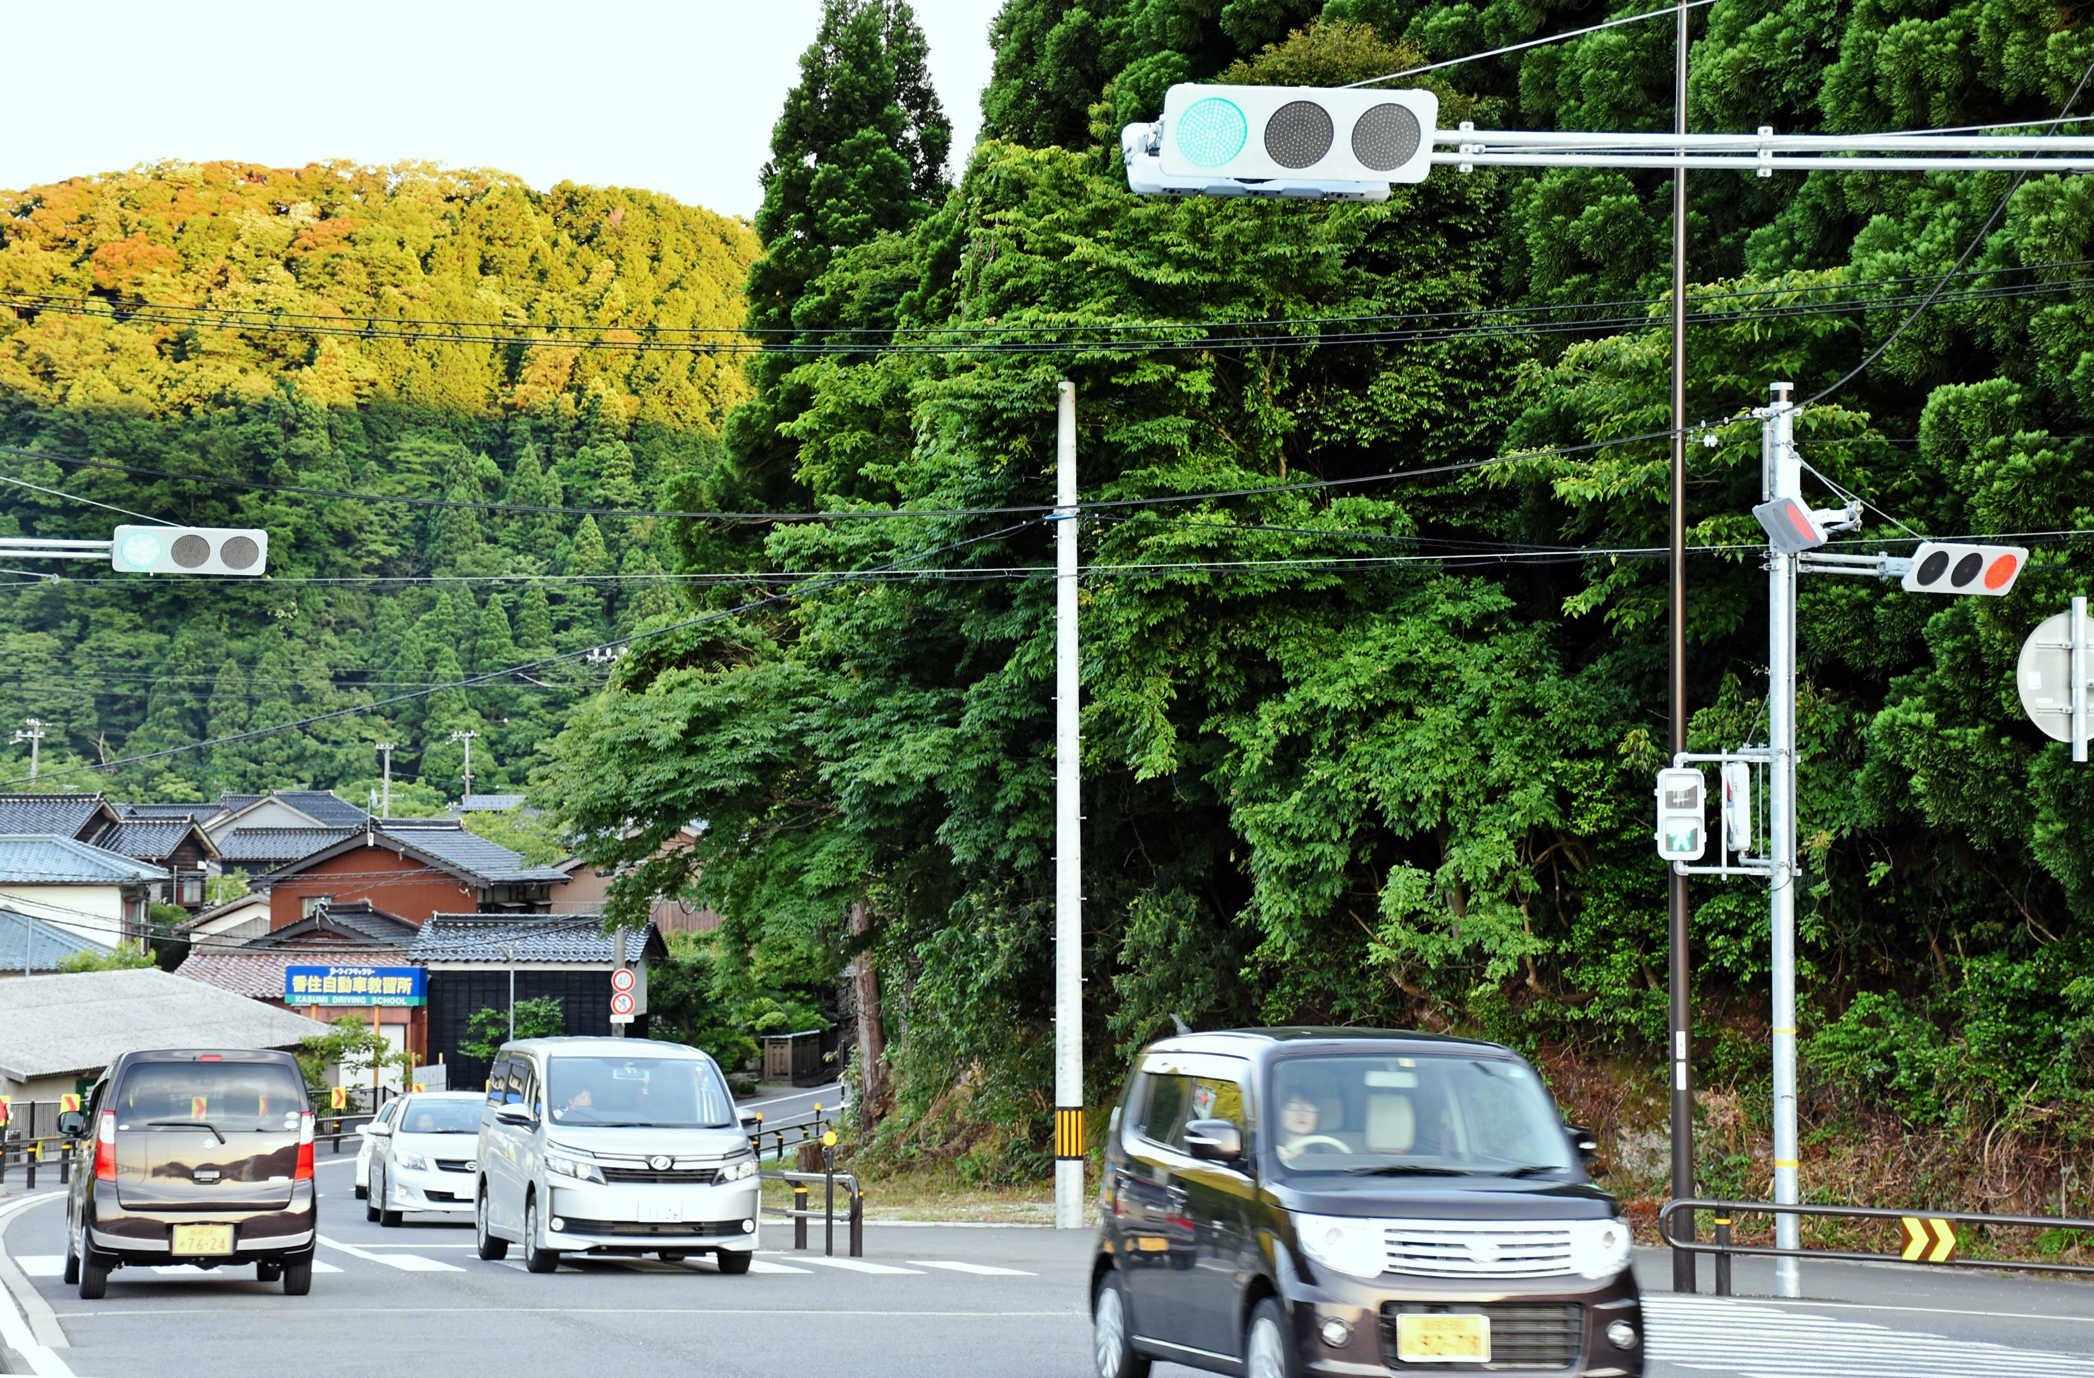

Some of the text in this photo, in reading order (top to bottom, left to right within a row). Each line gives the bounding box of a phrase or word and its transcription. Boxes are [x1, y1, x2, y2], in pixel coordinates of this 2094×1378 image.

[292, 975, 413, 994] 香住自動車教習所
[295, 995, 407, 1005] KASUMI DRIVING SCHOOL
